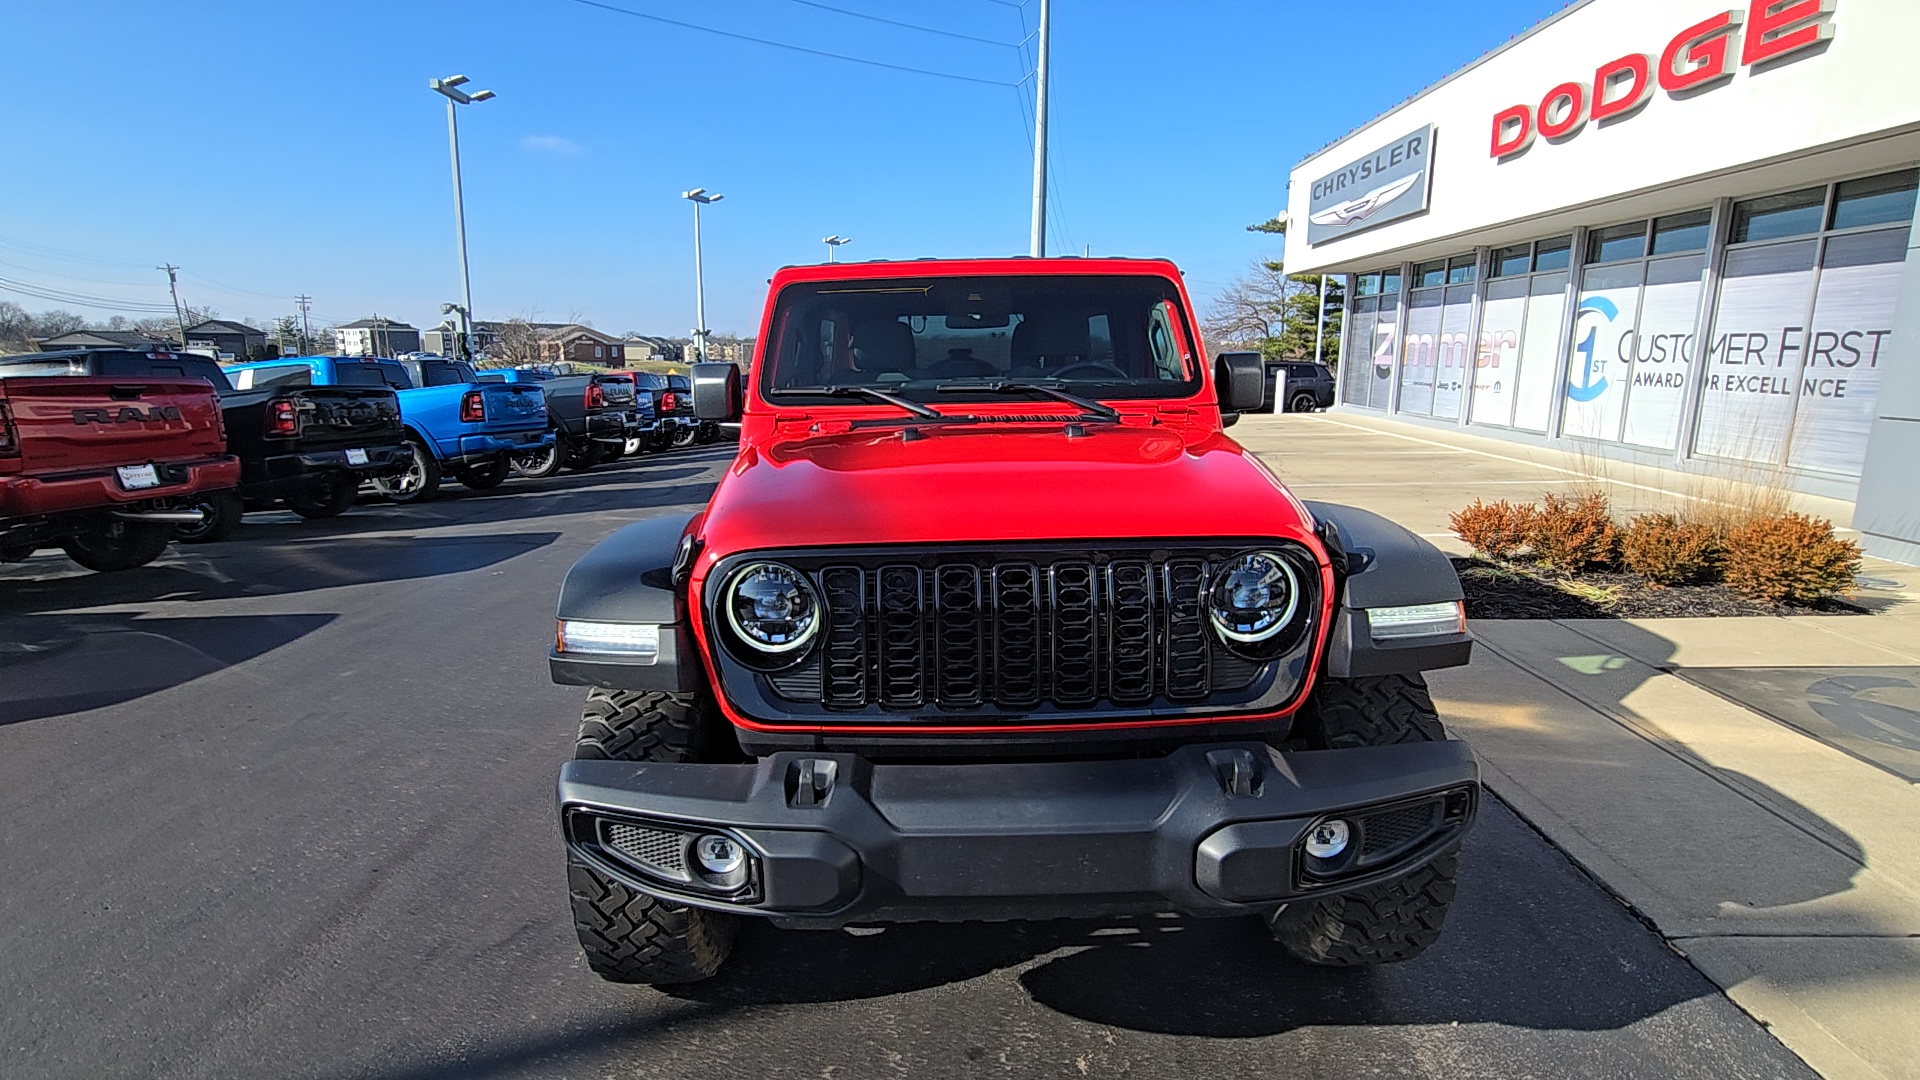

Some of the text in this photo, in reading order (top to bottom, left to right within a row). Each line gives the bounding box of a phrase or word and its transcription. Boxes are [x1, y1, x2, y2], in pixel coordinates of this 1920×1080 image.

[1490, 0, 1835, 158] DODGE
[1312, 136, 1422, 201] CHRYSLER
[1374, 322, 1517, 368] Zmmer
[1777, 326, 1892, 368] FIRST
[1632, 371, 1685, 389] AWARD
[1725, 374, 1848, 399] EXCELLNCE
[71, 406, 182, 426] RAM
